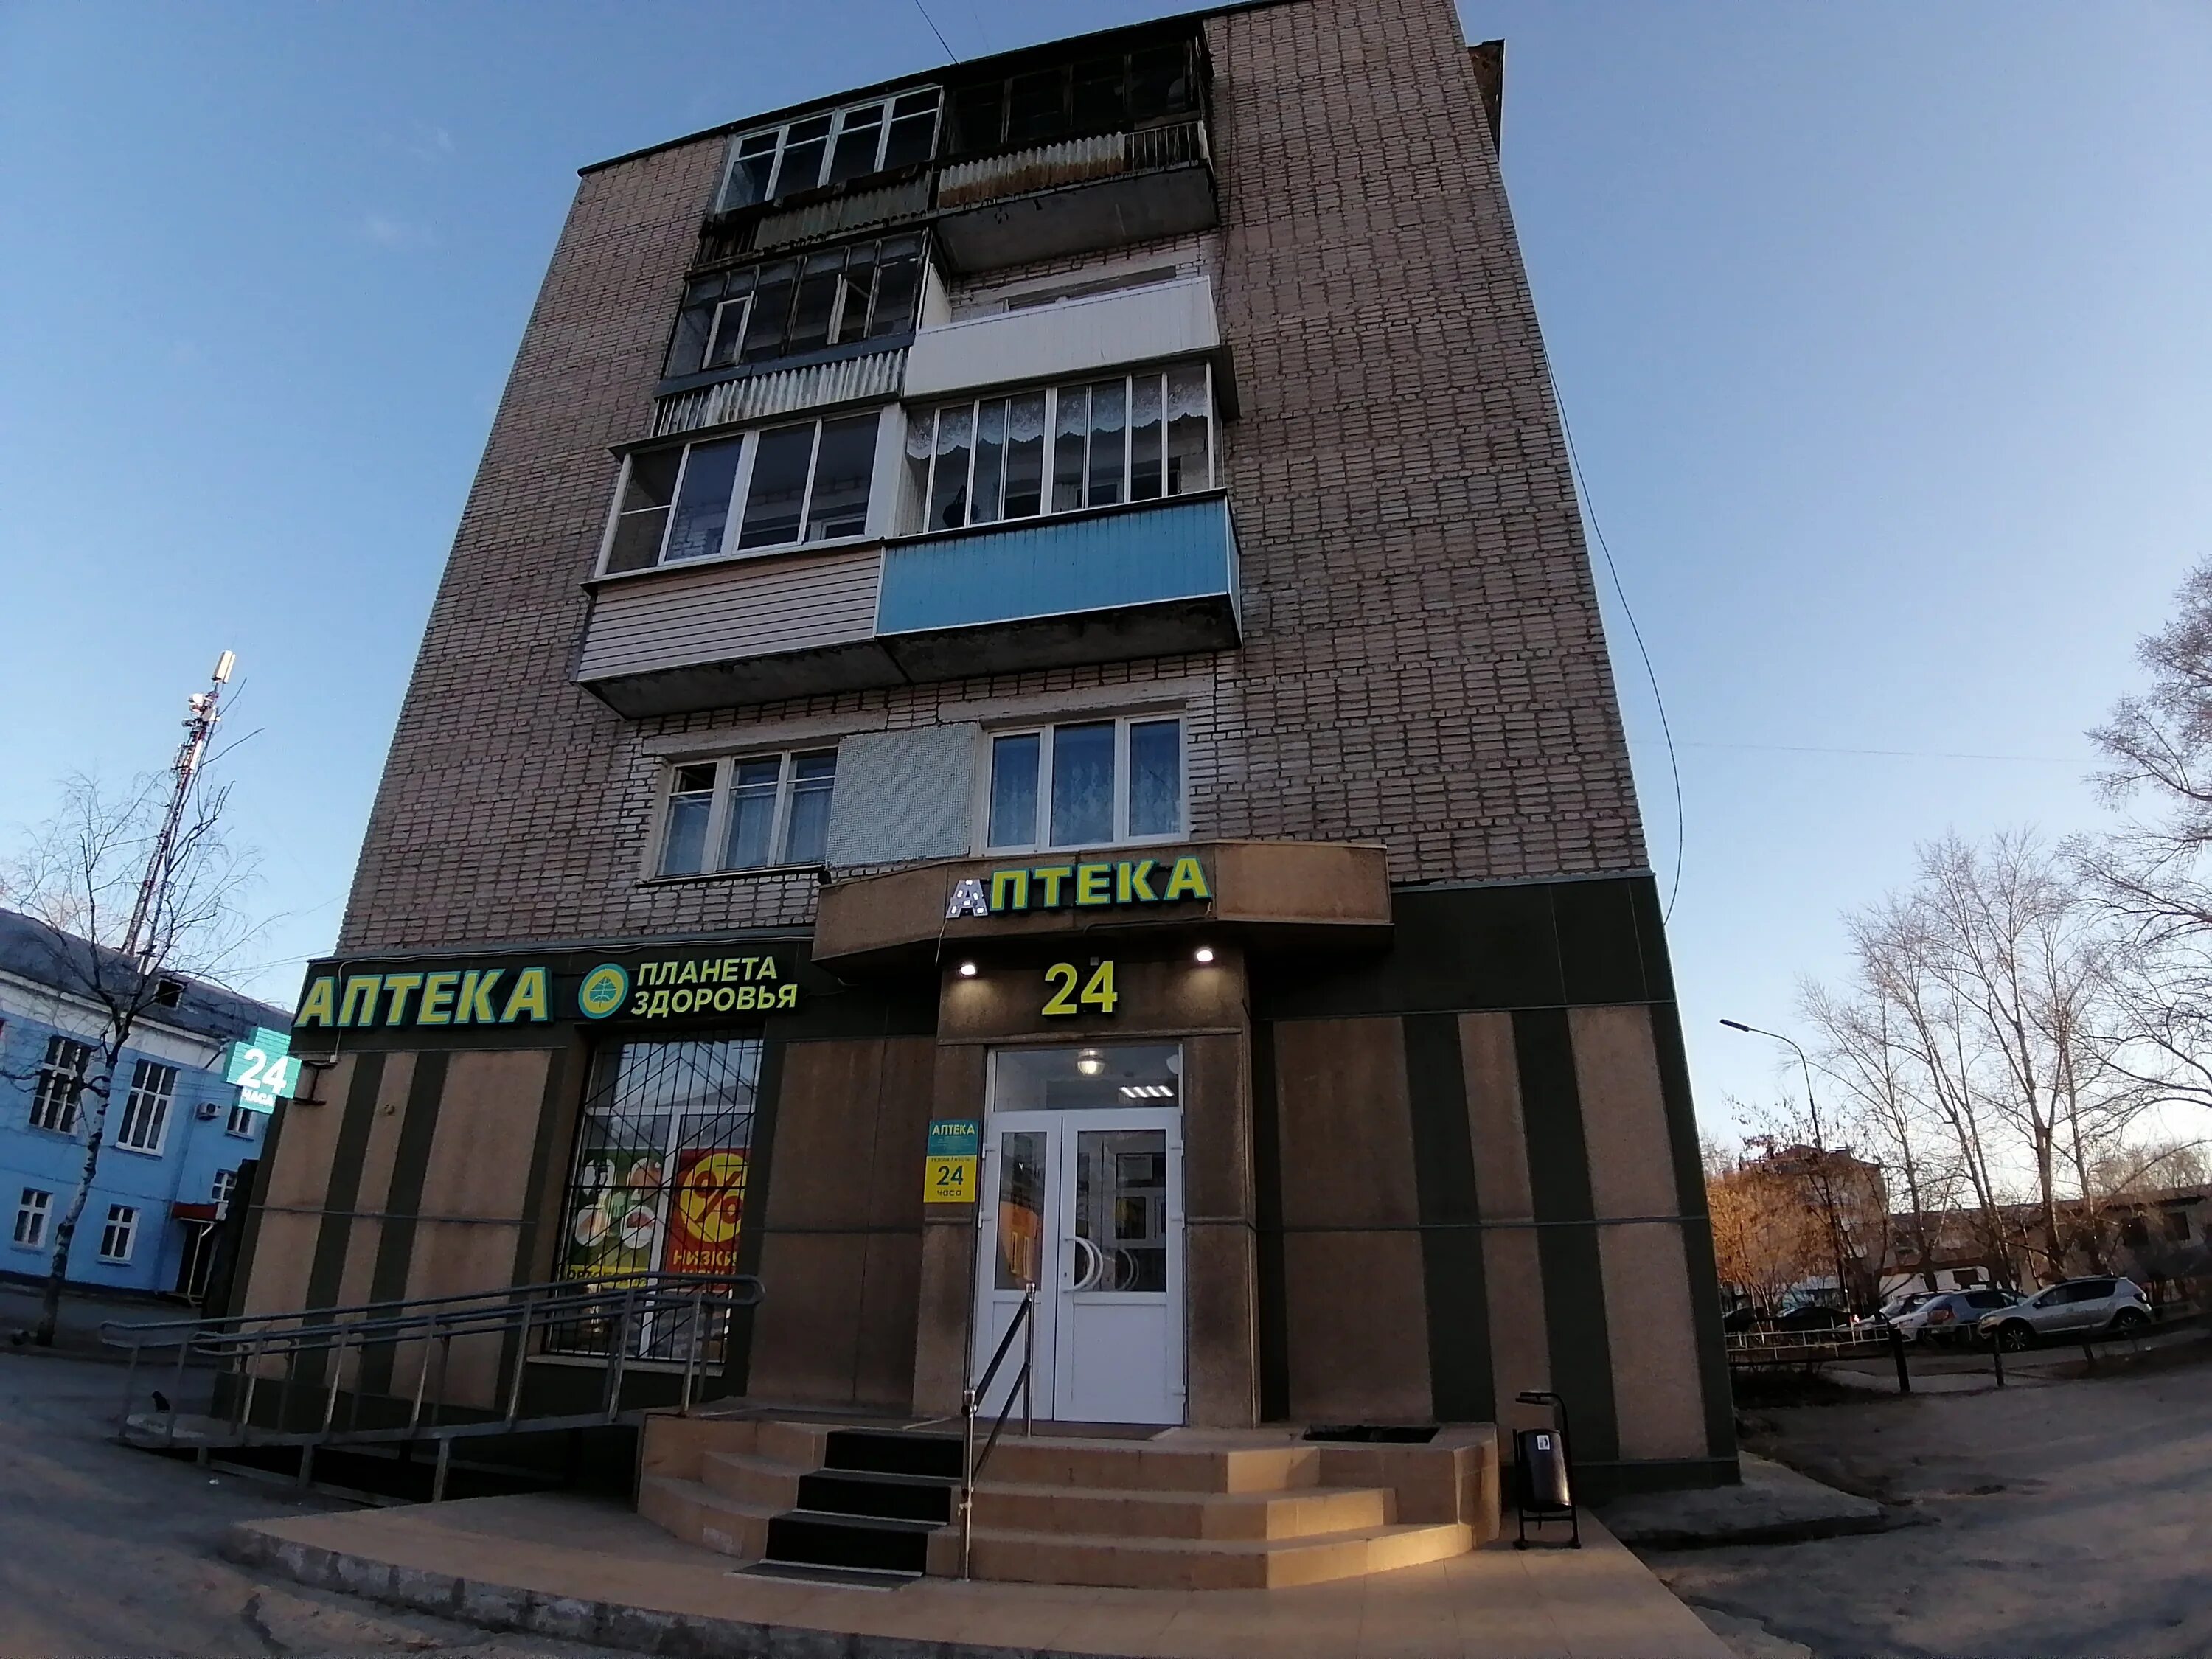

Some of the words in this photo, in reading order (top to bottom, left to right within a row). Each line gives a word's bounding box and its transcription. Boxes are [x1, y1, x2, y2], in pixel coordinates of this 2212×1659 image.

[945, 855, 1211, 919] АПТЕКА
[636, 956, 779, 986] ПЛАНЕТА
[1040, 960, 1118, 1015] 24
[294, 967, 550, 1027] АПТЕКА
[630, 982, 799, 1019] ЗДОРОВЬЯ
[236, 1048, 288, 1096] 24
[932, 1124, 975, 1135] АПТЕКА
[936, 1165, 964, 1186] 24
